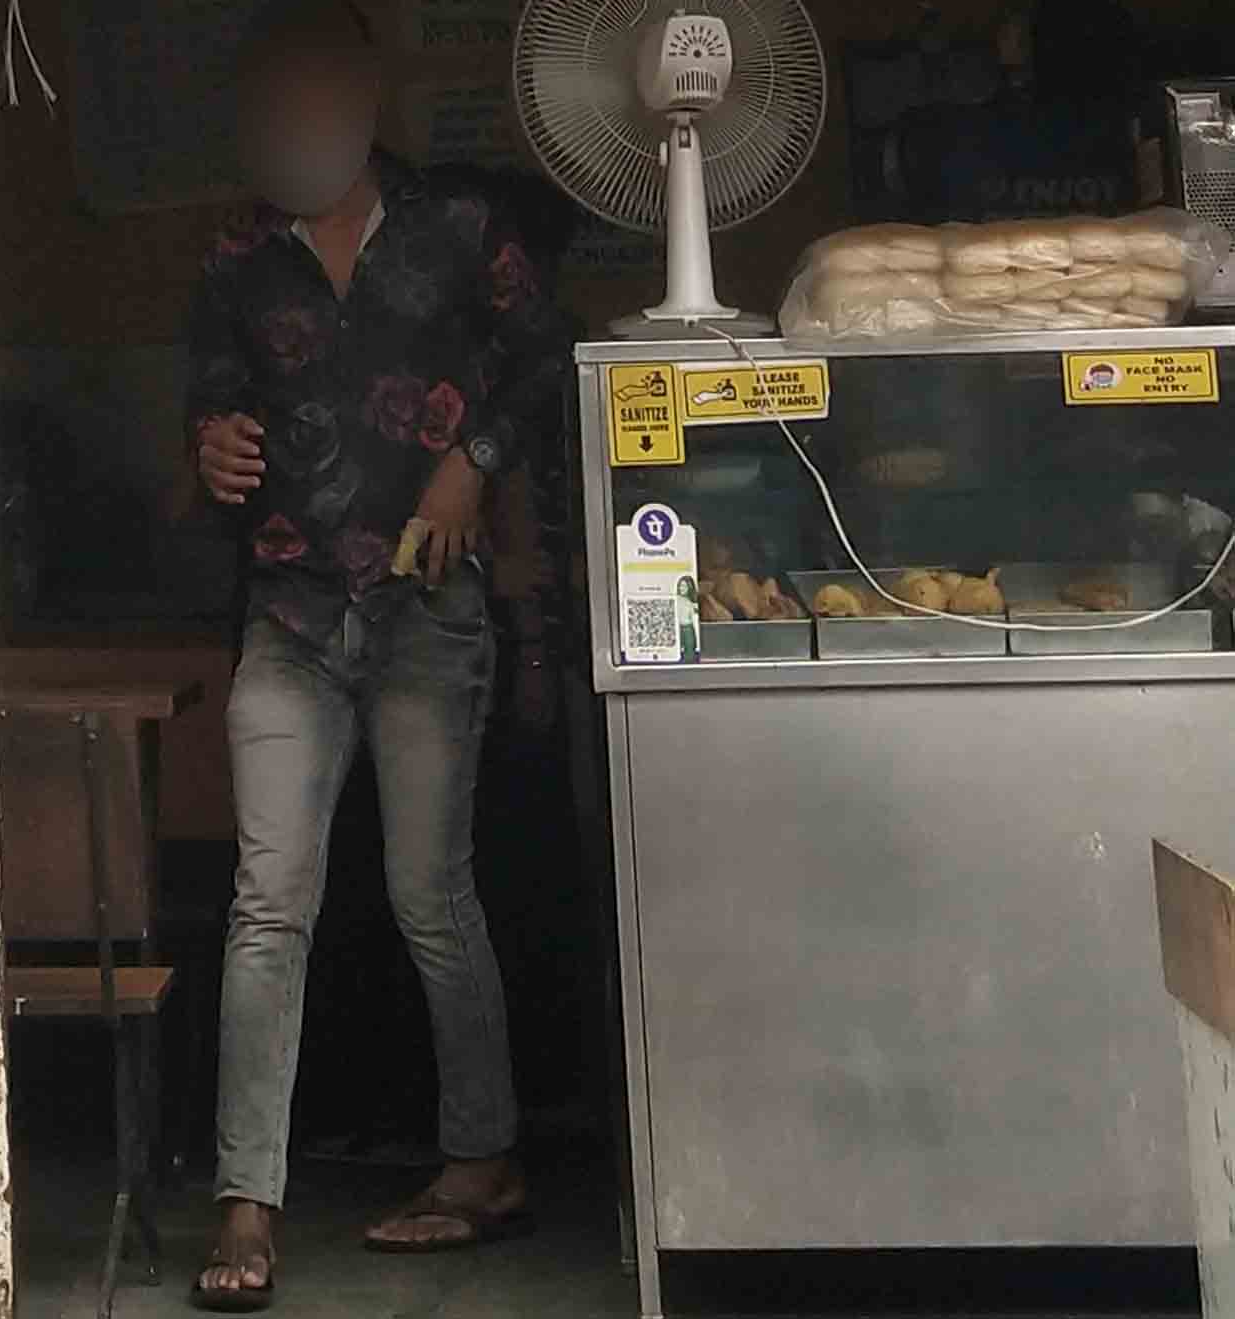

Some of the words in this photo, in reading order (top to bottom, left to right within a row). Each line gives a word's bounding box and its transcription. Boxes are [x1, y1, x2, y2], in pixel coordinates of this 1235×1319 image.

[1126, 366, 1160, 375] FACE
[1164, 365, 1203, 374] MASK
[1144, 383, 1189, 392] ENTRY
[777, 395, 818, 407] HANDS
[621, 406, 669, 422] SANITIZE
